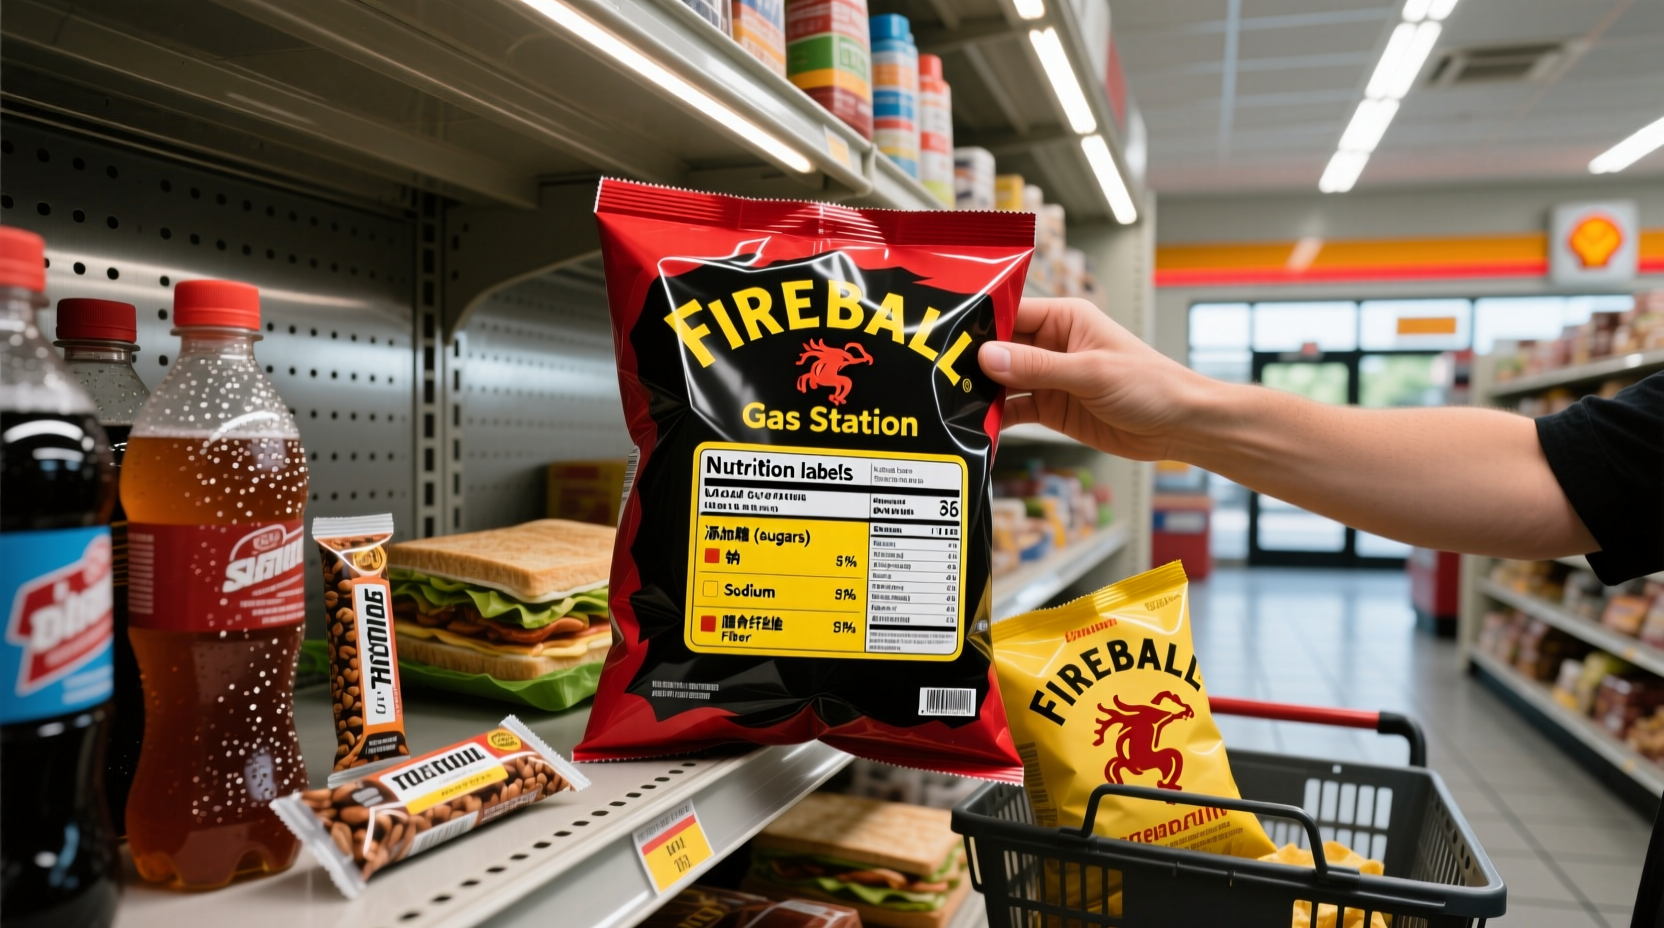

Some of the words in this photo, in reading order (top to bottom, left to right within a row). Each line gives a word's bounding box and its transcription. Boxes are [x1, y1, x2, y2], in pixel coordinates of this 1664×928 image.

[664, 279, 973, 387] FIREBALL
[742, 402, 801, 432] Gas
[809, 405, 919, 437] Station
[706, 456, 795, 479] Nutrition
[800, 462, 854, 481] labels
[724, 583, 776, 599] Sodium
[1029, 638, 1203, 727] FIREBALL
